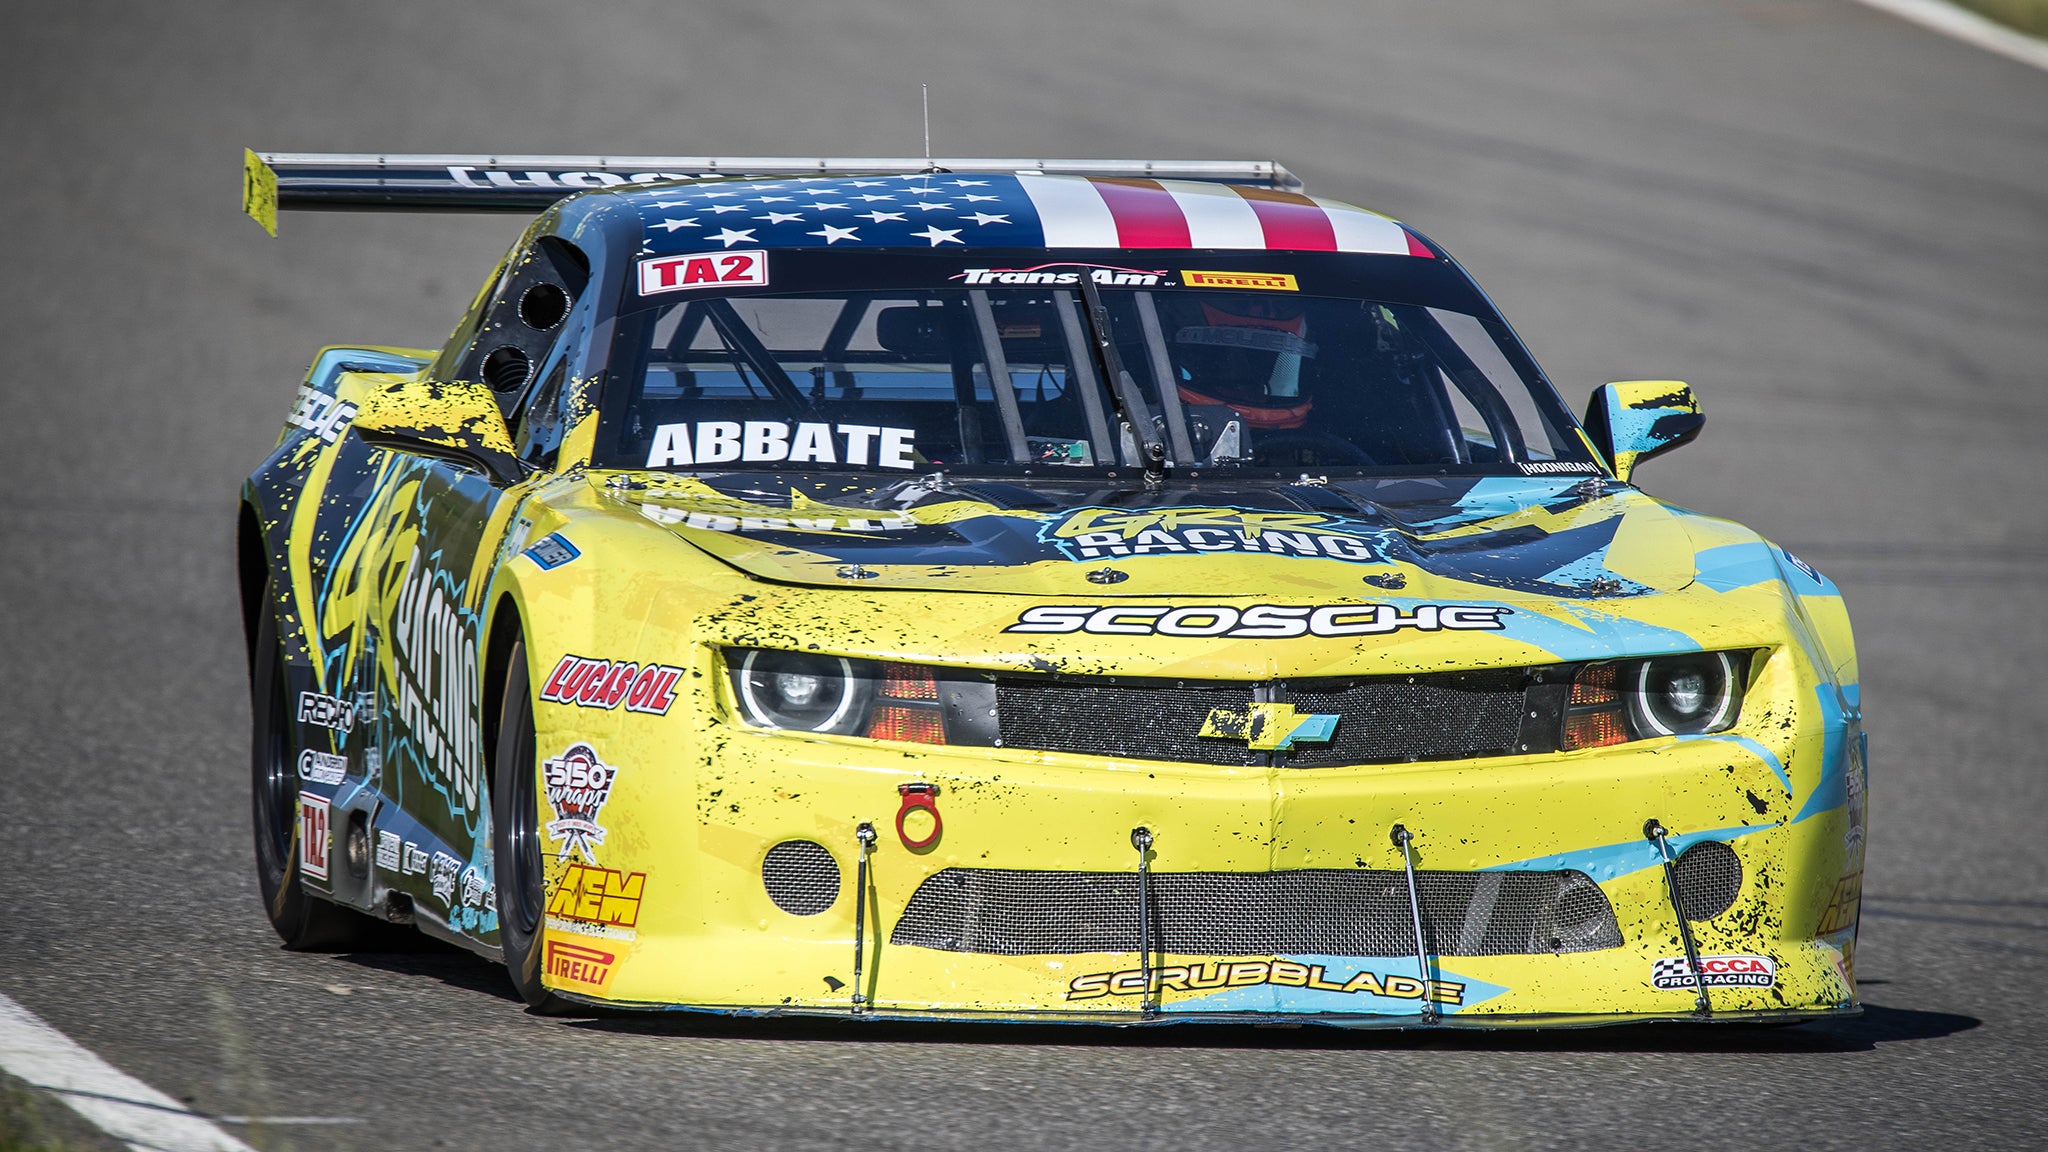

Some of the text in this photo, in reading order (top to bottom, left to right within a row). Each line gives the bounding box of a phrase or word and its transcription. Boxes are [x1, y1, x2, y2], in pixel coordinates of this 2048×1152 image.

[651, 256, 754, 287] TA2
[963, 268, 1080, 285] Trans
[1089, 269, 1158, 286] Am
[1193, 273, 1287, 287] PIRELLI
[646, 420, 915, 469] ABBATE
[1075, 527, 1372, 560] RACING
[1000, 603, 1506, 639] SCOSCHE
[396, 543, 478, 812] RACING
[539, 653, 687, 716] LUCAS OIL
[549, 759, 608, 790] 5150
[550, 786, 603, 814] wraps
[303, 804, 325, 868] TA2
[546, 863, 646, 928] AEM
[546, 940, 615, 985] PIRELLI
[1659, 974, 1769, 987] PRO RACING
[1066, 959, 1467, 1006] SCRUBBLADE
